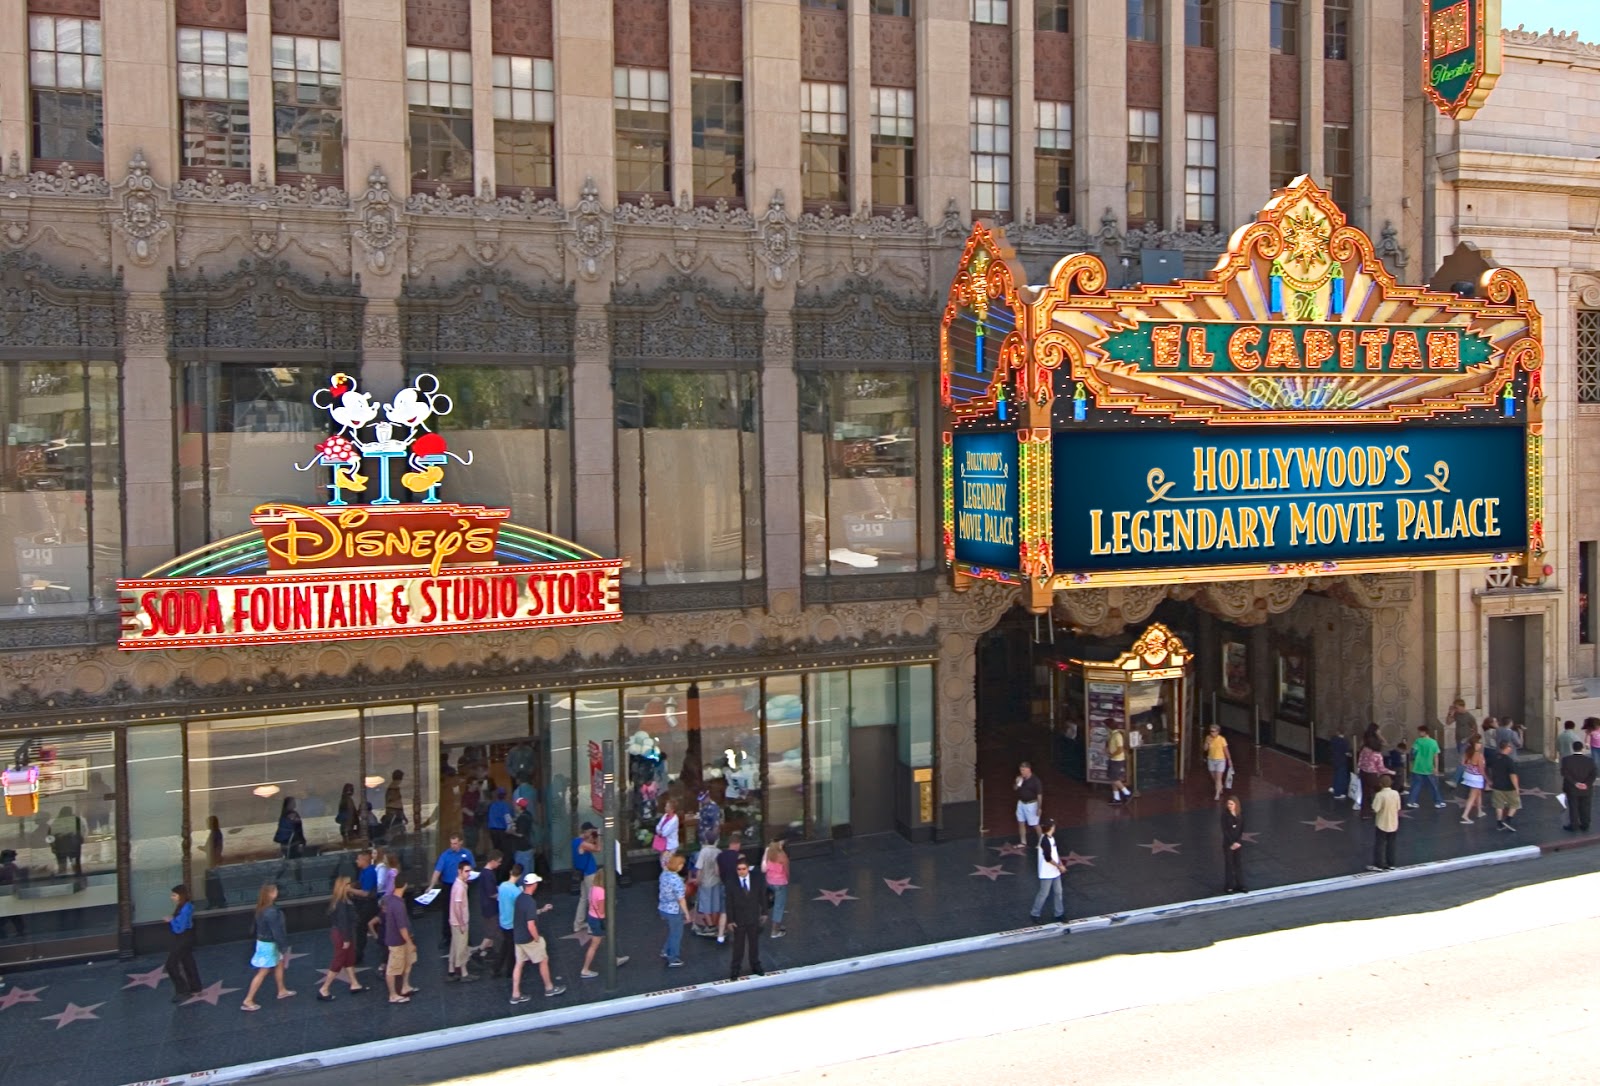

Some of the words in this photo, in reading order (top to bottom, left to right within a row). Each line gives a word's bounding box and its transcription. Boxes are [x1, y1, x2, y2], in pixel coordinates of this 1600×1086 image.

[1151, 324, 1215, 369] EL
[1228, 325, 1461, 373] CAPITAN
[1248, 377, 1361, 409] Theatre
[1193, 445, 1412, 491] HOLLYWOOD'S
[962, 480, 1007, 511] LEGENDARY
[959, 511, 983, 541] MOVIE
[984, 513, 1014, 546] PALACE
[1090, 505, 1280, 555] LEGENDARY
[1289, 501, 1385, 546] MOVIE
[1397, 498, 1501, 540] PALACE
[141, 587, 224, 637] SODA
[233, 582, 378, 633] FOUNTAIN
[391, 585, 409, 625] &
[421, 575, 516, 624] STUDIO
[526, 571, 607, 619] STORE
